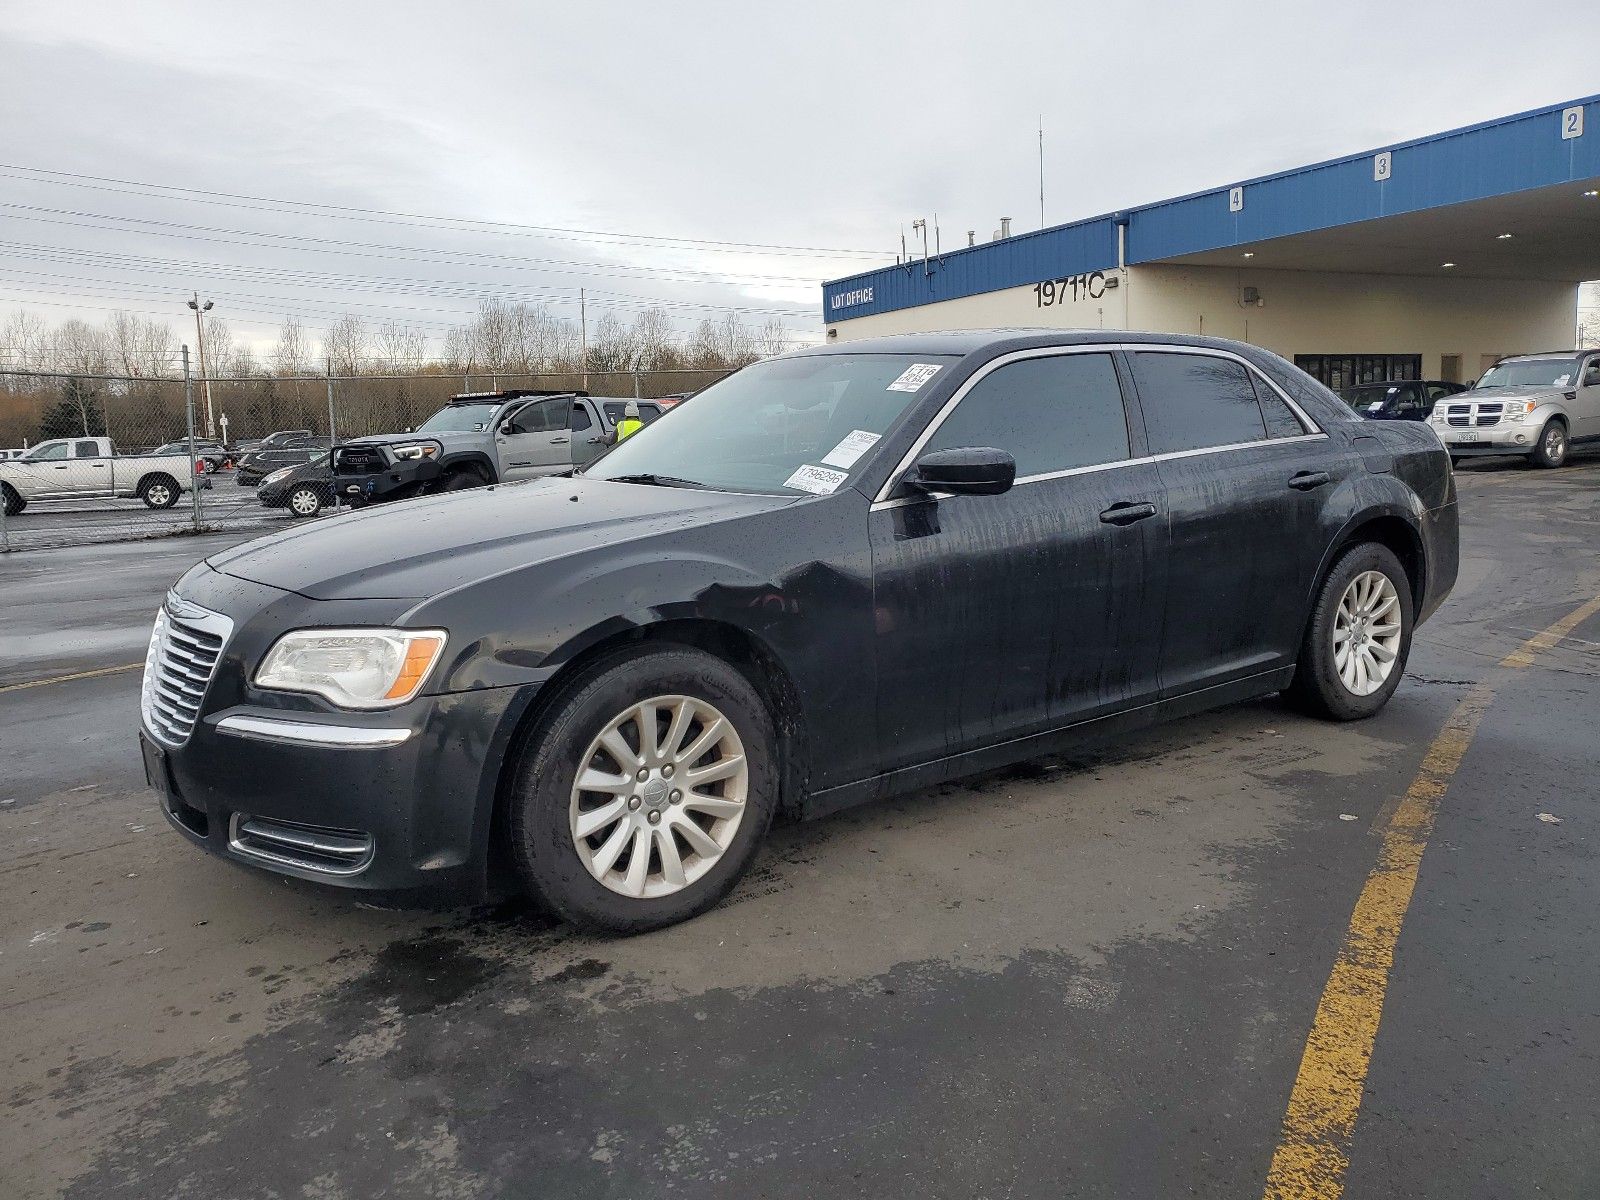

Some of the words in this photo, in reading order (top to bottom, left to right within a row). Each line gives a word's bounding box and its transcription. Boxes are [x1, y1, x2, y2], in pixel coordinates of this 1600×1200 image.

[1566, 112, 1578, 133] 2
[1378, 157, 1388, 175] 3
[1232, 190, 1240, 207] 4
[831, 294, 845, 309] LOT
[846, 287, 874, 306] OFFICE
